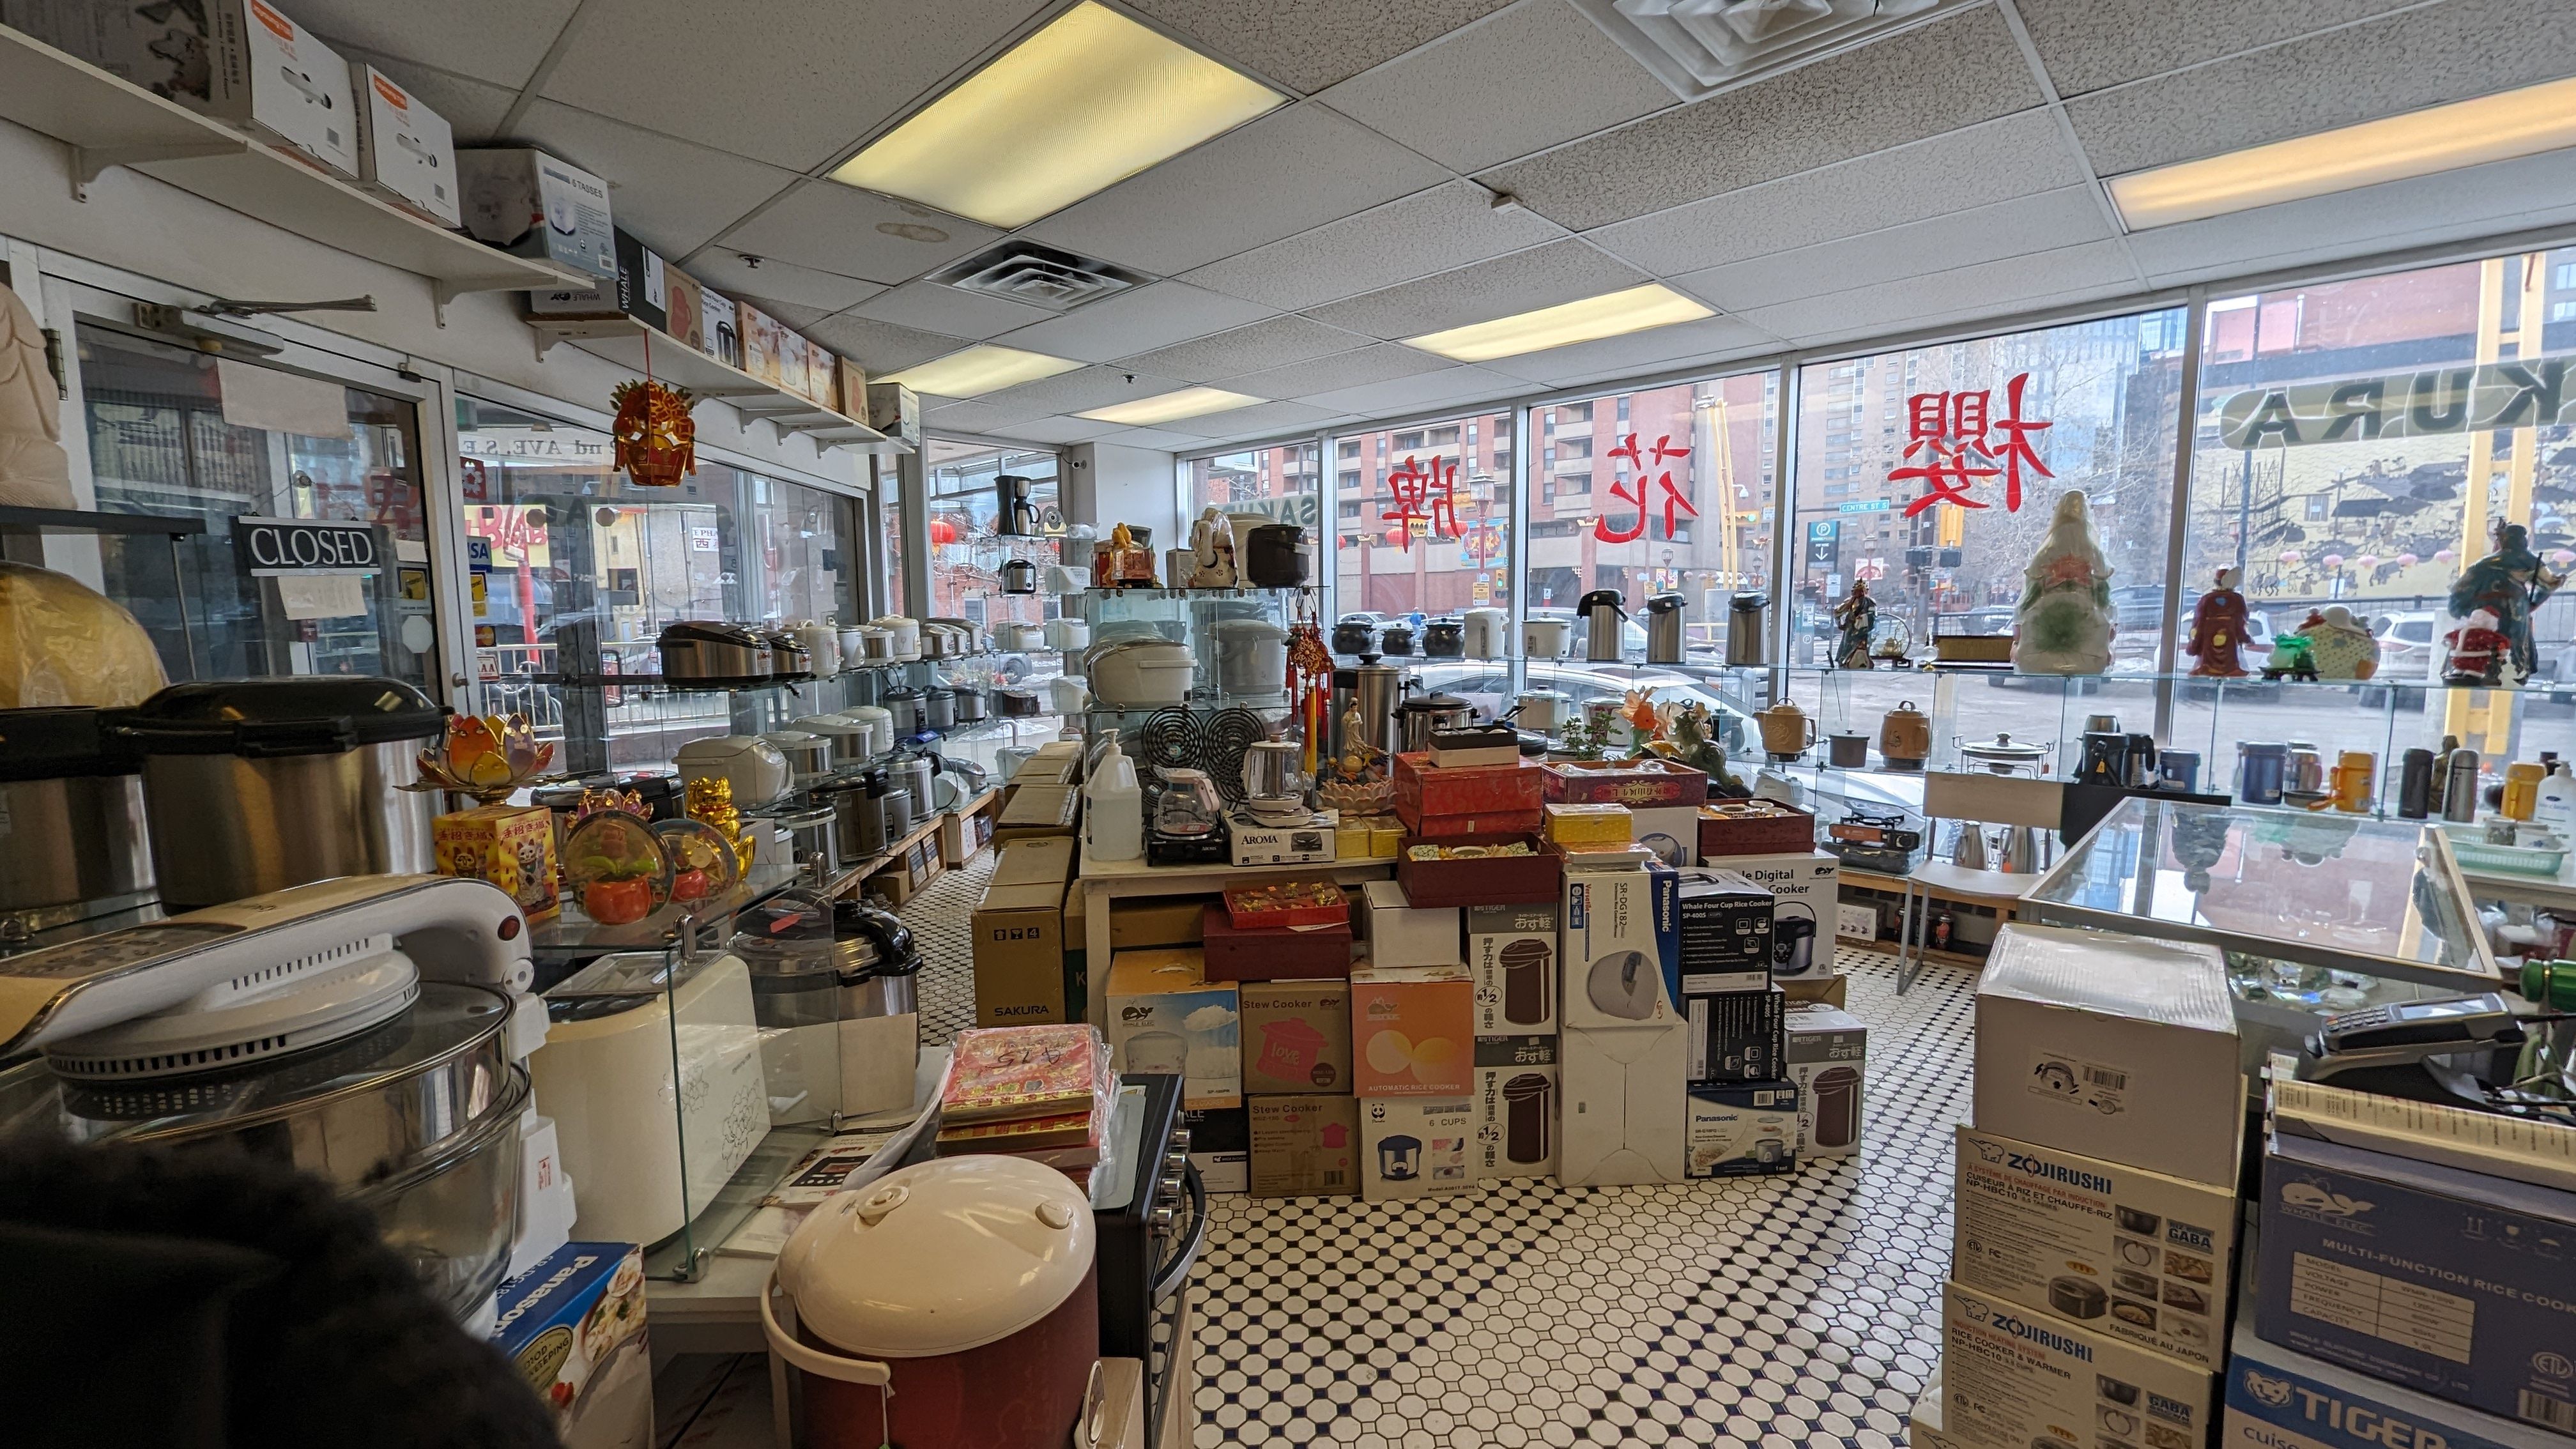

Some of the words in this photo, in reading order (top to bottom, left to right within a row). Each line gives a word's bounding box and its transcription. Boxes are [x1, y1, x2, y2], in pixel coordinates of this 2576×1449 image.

[618, 266, 631, 310] WHALE
[1842, 503, 1869, 512] CENTRE
[249, 526, 374, 568] CLOSED
[1241, 834, 1278, 845] AROMA
[1755, 869, 1794, 882] Digital
[1768, 884, 1810, 894] Cooker
[1618, 882, 1628, 926] SR-DG182
[1662, 880, 1673, 933] Panasonic
[1515, 917, 1552, 931] おす軽
[994, 1004, 1050, 1016] SAKURA
[1243, 1000, 1270, 1009] Stew
[1273, 999, 1312, 1009] Cooker
[1515, 1050, 1551, 1064] おす軽
[1252, 1105, 1280, 1114] Stew
[1282, 1104, 1323, 1114] Cooker
[1695, 1114, 1738, 1123] Panasonic
[1441, 1117, 1468, 1126] CUPS
[2007, 1153, 2112, 1195] ZOJIRUSHI
[1966, 1177, 2018, 1200] NP-HBC10
[1966, 1171, 2005, 1188] CUISEUR
[2016, 1185, 2031, 1197] RIZ
[2033, 1191, 2045, 1200] ET
[2048, 1195, 2113, 1220] CHAUFFE-RIZ
[2168, 1227, 2212, 1249] GABA
[2305, 1257, 2342, 1273] MODEL
[2322, 1238, 2469, 1287] MULTI-FUNCTION
[2474, 1278, 2518, 1299] RICE
[2304, 1281, 2341, 1298] POWER
[2305, 1269, 2350, 1288] VOLTAGE
[2303, 1293, 2364, 1316] FREQUENCY
[2303, 1307, 2350, 1326] CAPACITY
[1952, 1319, 1987, 1338] INDUCTION
[1988, 1330, 2016, 1350] HEATING
[1991, 1312, 2093, 1363] ZOJIRUSHI
[1951, 1336, 2002, 1361] NP-HBC10
[1951, 1327, 1973, 1342] RICE
[1975, 1337, 2015, 1358] COOKER
[2018, 1353, 2024, 1361] &
[2027, 1357, 2071, 1380] WARMER
[2159, 1340, 2174, 1351] AU
[2175, 1346, 2209, 1363] JAPON
[2149, 1395, 2190, 1418] GABA
